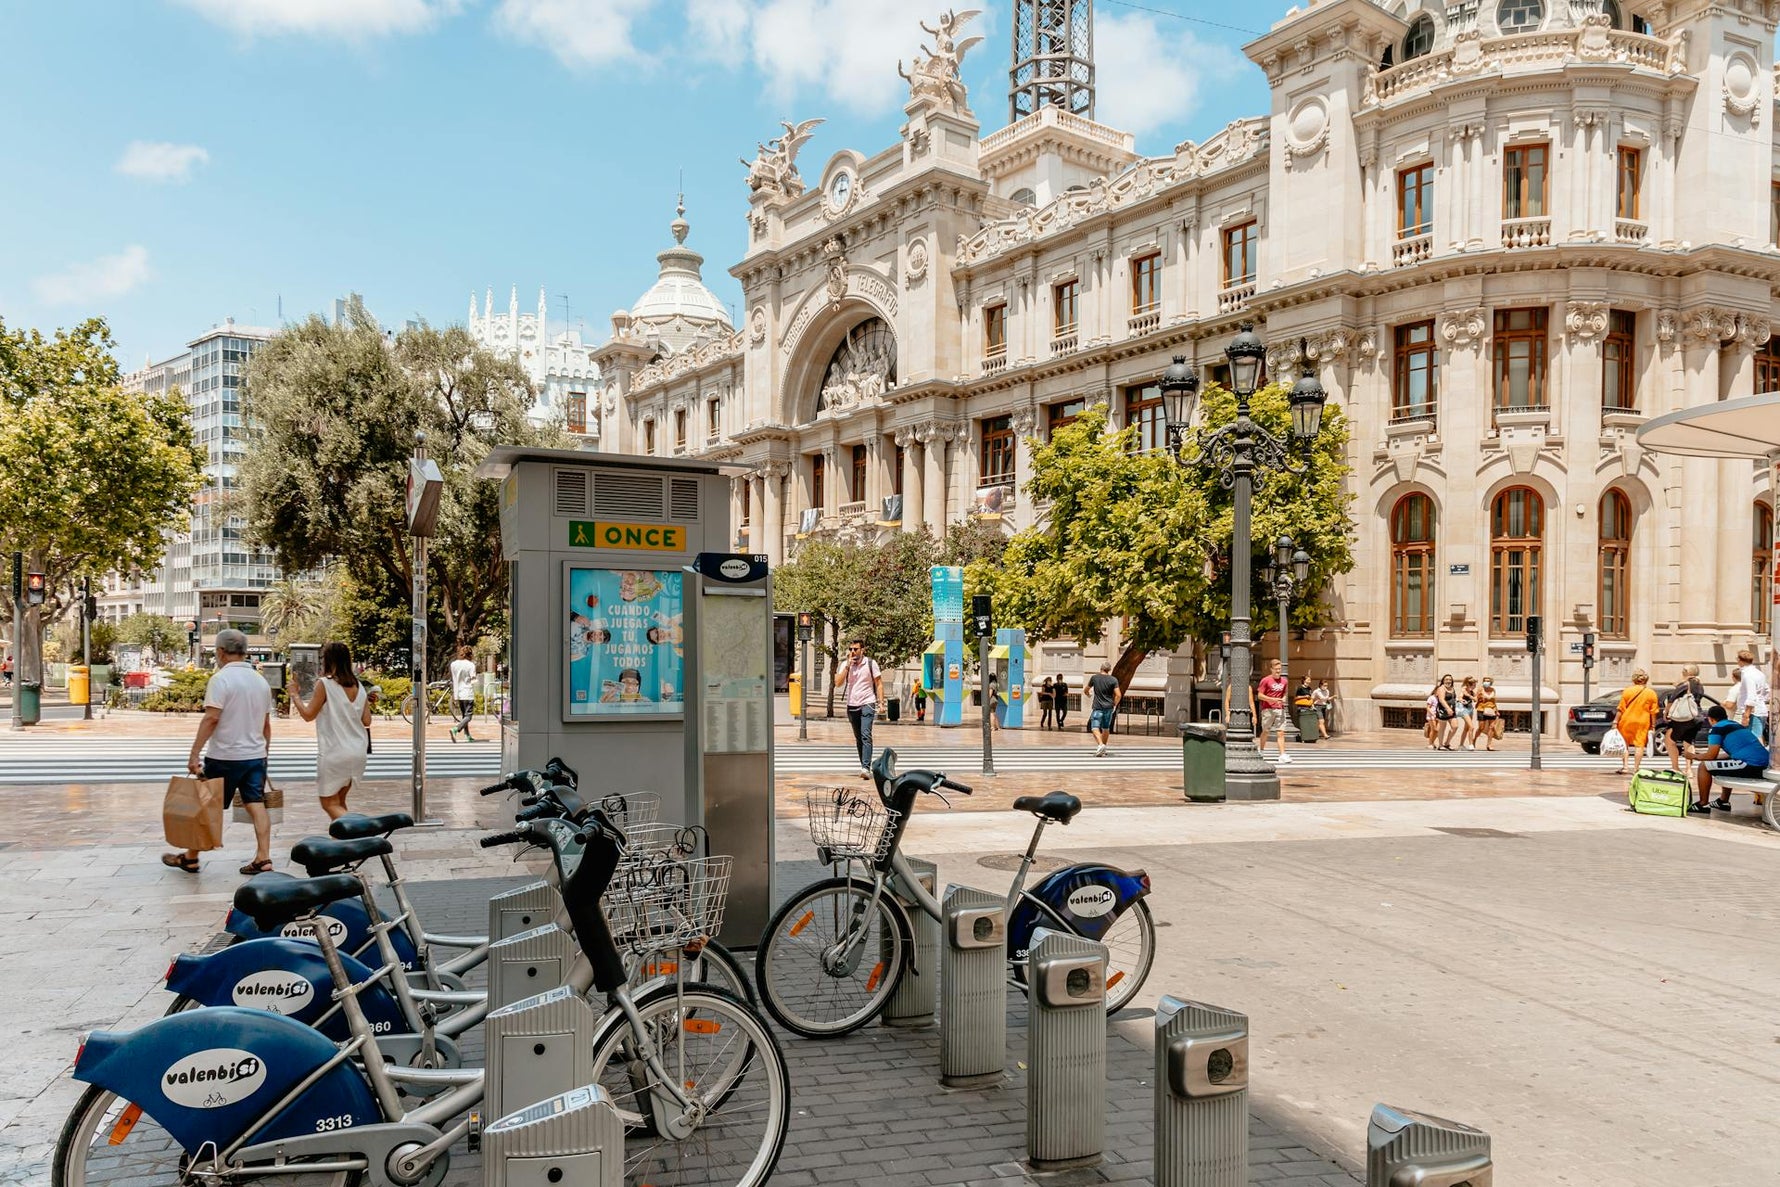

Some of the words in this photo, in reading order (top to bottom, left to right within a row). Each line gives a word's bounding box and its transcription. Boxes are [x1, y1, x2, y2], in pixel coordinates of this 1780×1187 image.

[605, 526, 677, 547] ONCE
[754, 555, 768, 563] 015
[608, 604, 651, 617] CUANDO
[610, 617, 649, 629] JUEGAS
[605, 643, 654, 655] JUGAMOS
[613, 656, 647, 668] TODOS
[236, 980, 309, 998] valenbisi
[166, 1057, 260, 1086] valenbisi
[315, 1114, 353, 1132] 3313
